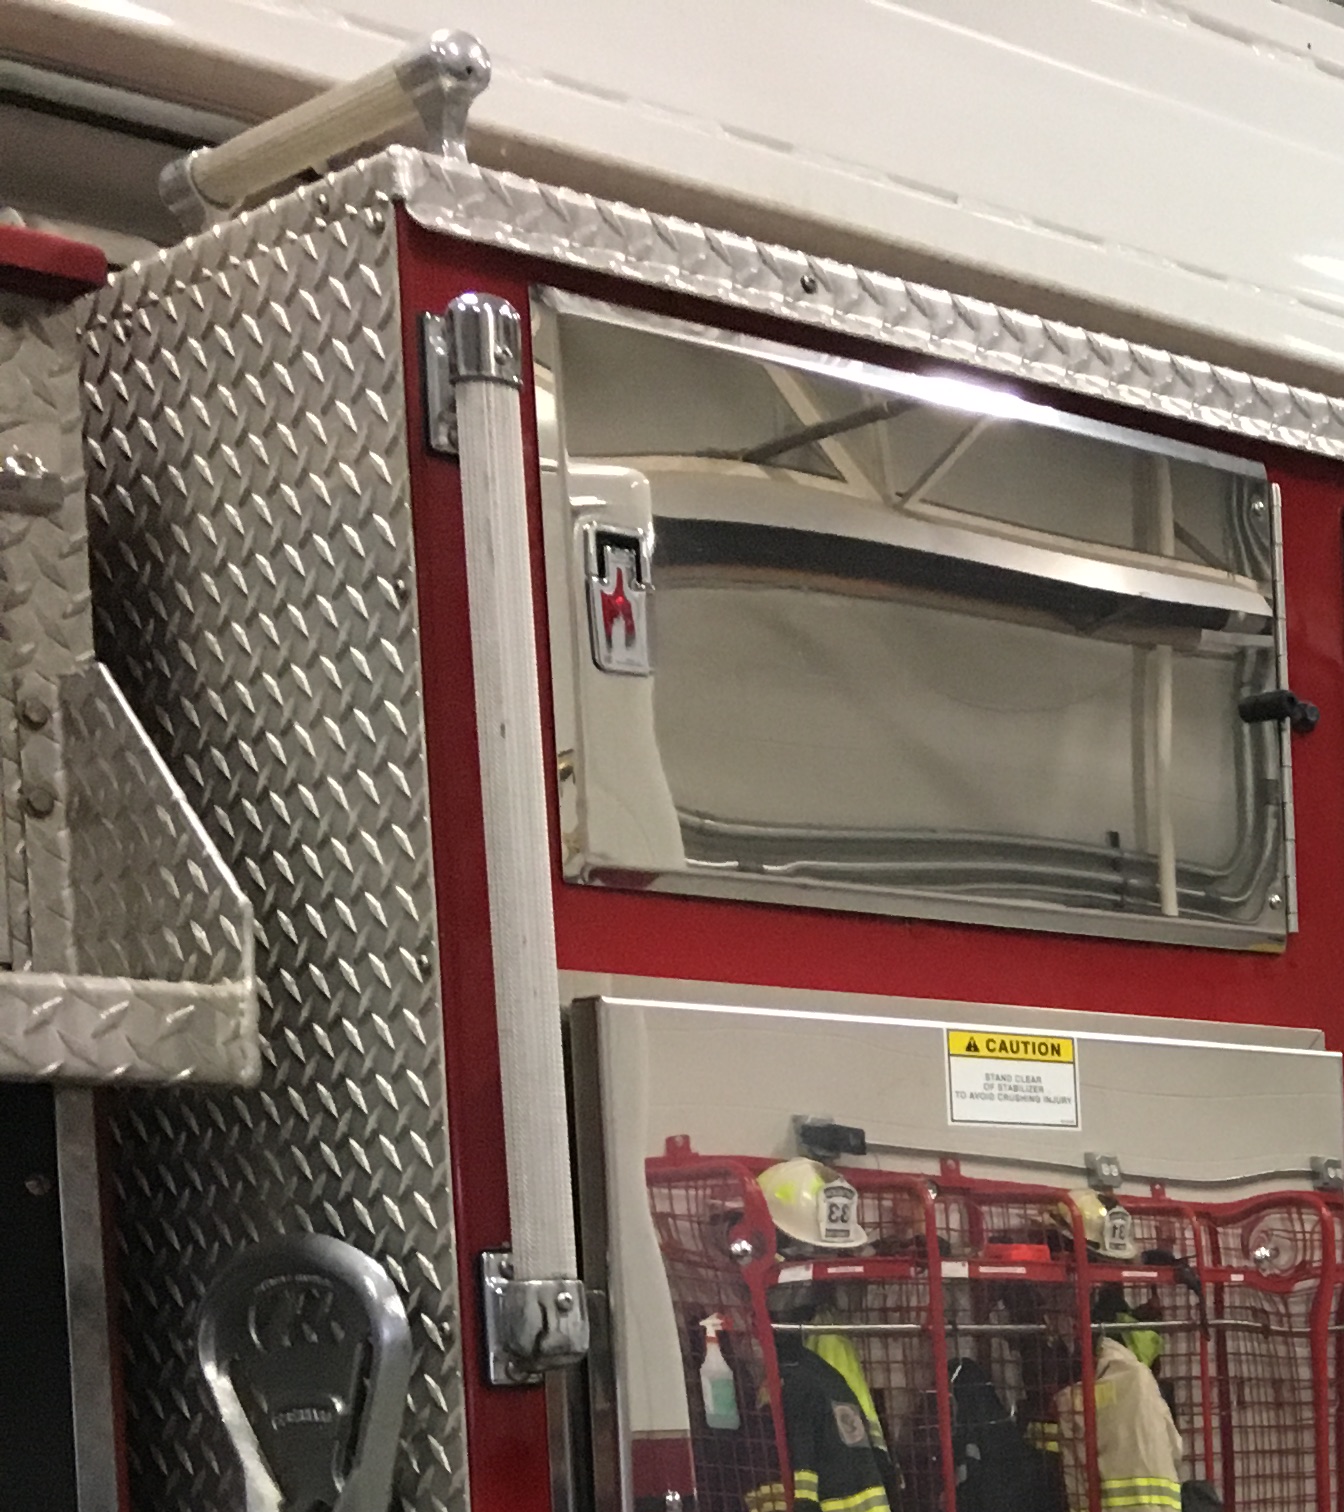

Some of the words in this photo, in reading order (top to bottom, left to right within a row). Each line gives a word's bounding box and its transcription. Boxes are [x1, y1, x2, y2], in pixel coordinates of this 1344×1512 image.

[985, 1038, 1061, 1057] CAUTION
[985, 1073, 1012, 1082] STAND
[1015, 1075, 1042, 1083] CLEAR
[983, 1083, 994, 1091] OF
[998, 1084, 1044, 1093] STABILIZER
[955, 1091, 966, 1099] TO
[969, 1091, 995, 1101] AVOID
[997, 1093, 1040, 1103] CRUSHING
[1043, 1096, 1072, 1105] INJURY
